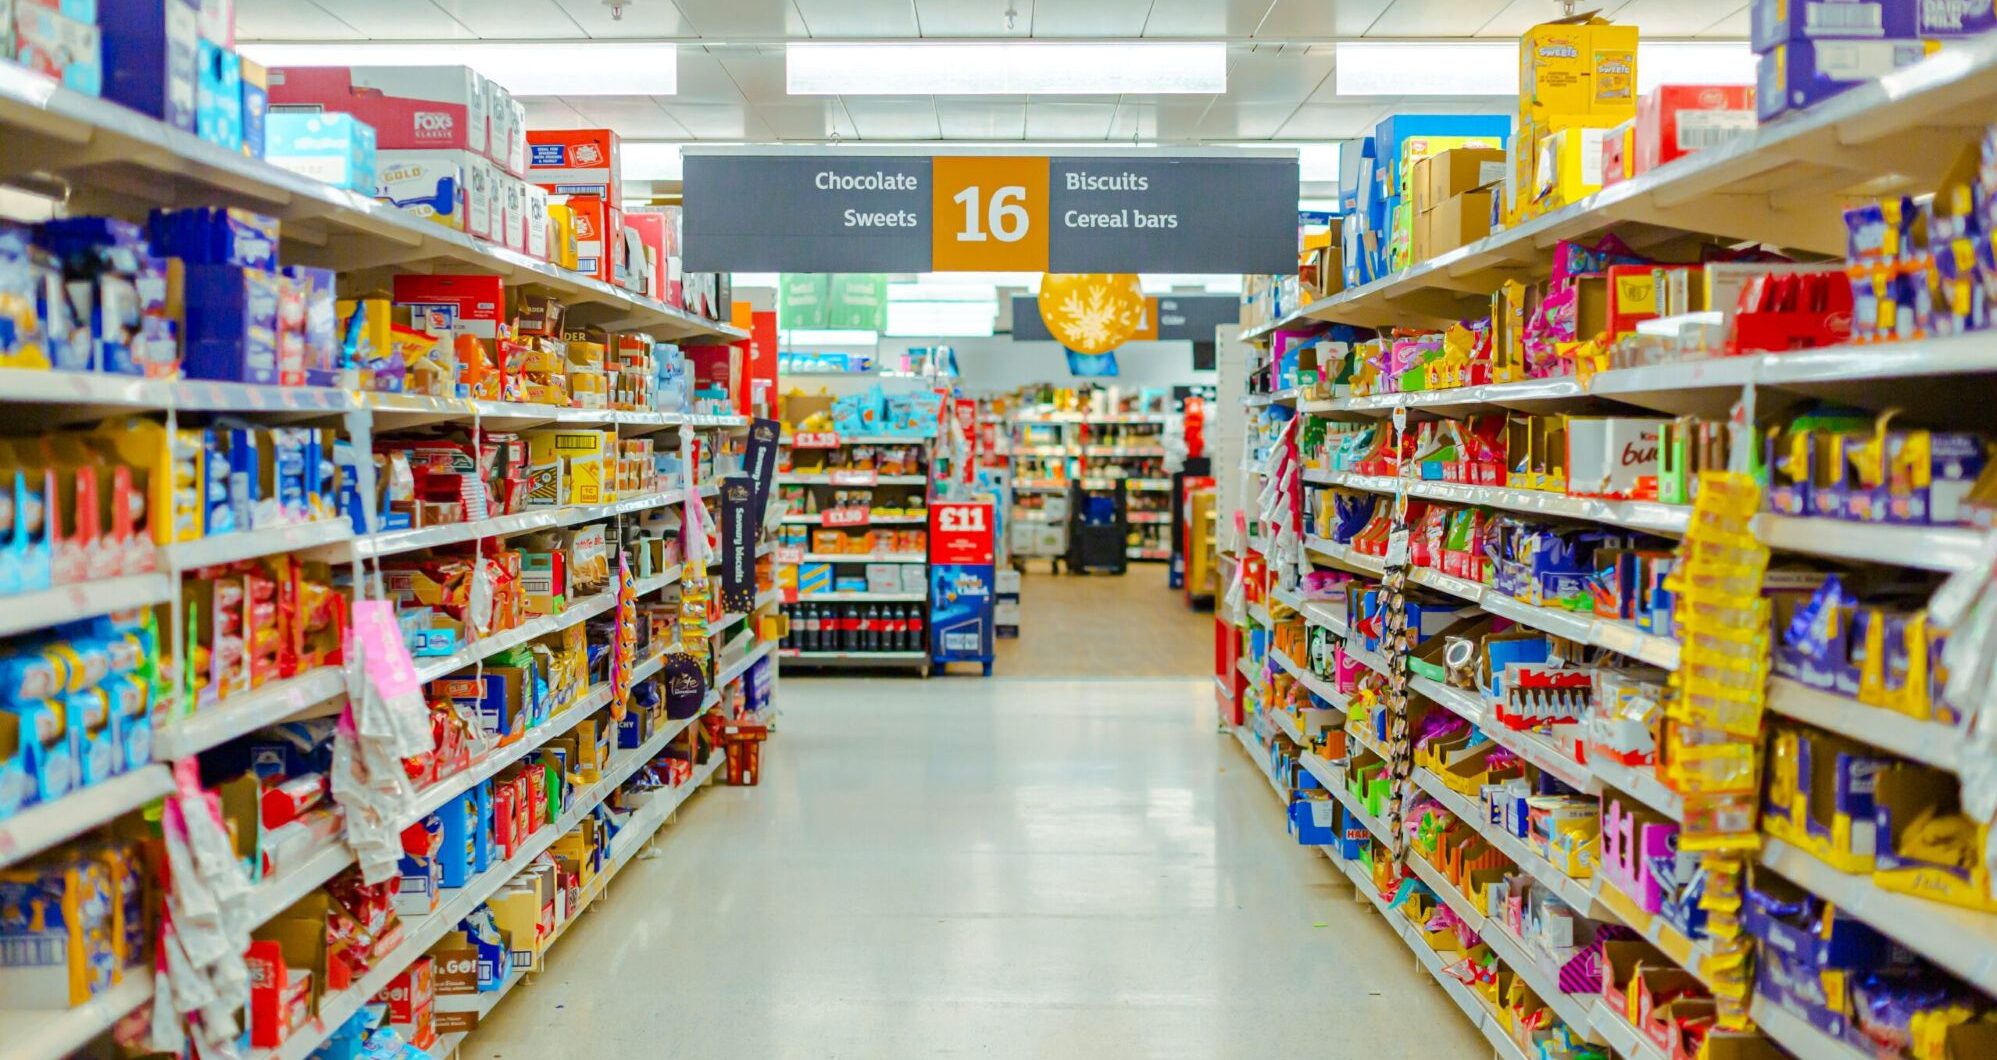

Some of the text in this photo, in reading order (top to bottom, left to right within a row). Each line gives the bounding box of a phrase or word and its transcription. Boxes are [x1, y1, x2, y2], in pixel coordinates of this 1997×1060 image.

[384, 168, 421, 182] GOLD
[815, 170, 918, 191] Chocolate
[1065, 171, 1149, 191] Biscuits
[844, 208, 918, 228] Sweets
[953, 185, 1030, 242] 16
[1064, 209, 1178, 229] Cereal bars
[564, 332, 586, 342] DER
[733, 507, 745, 546] Savoury
[939, 506, 987, 532] £11
[734, 545, 744, 584] biscuits
[618, 721, 635, 729] CHY
[1345, 829, 1370, 841] HAR
